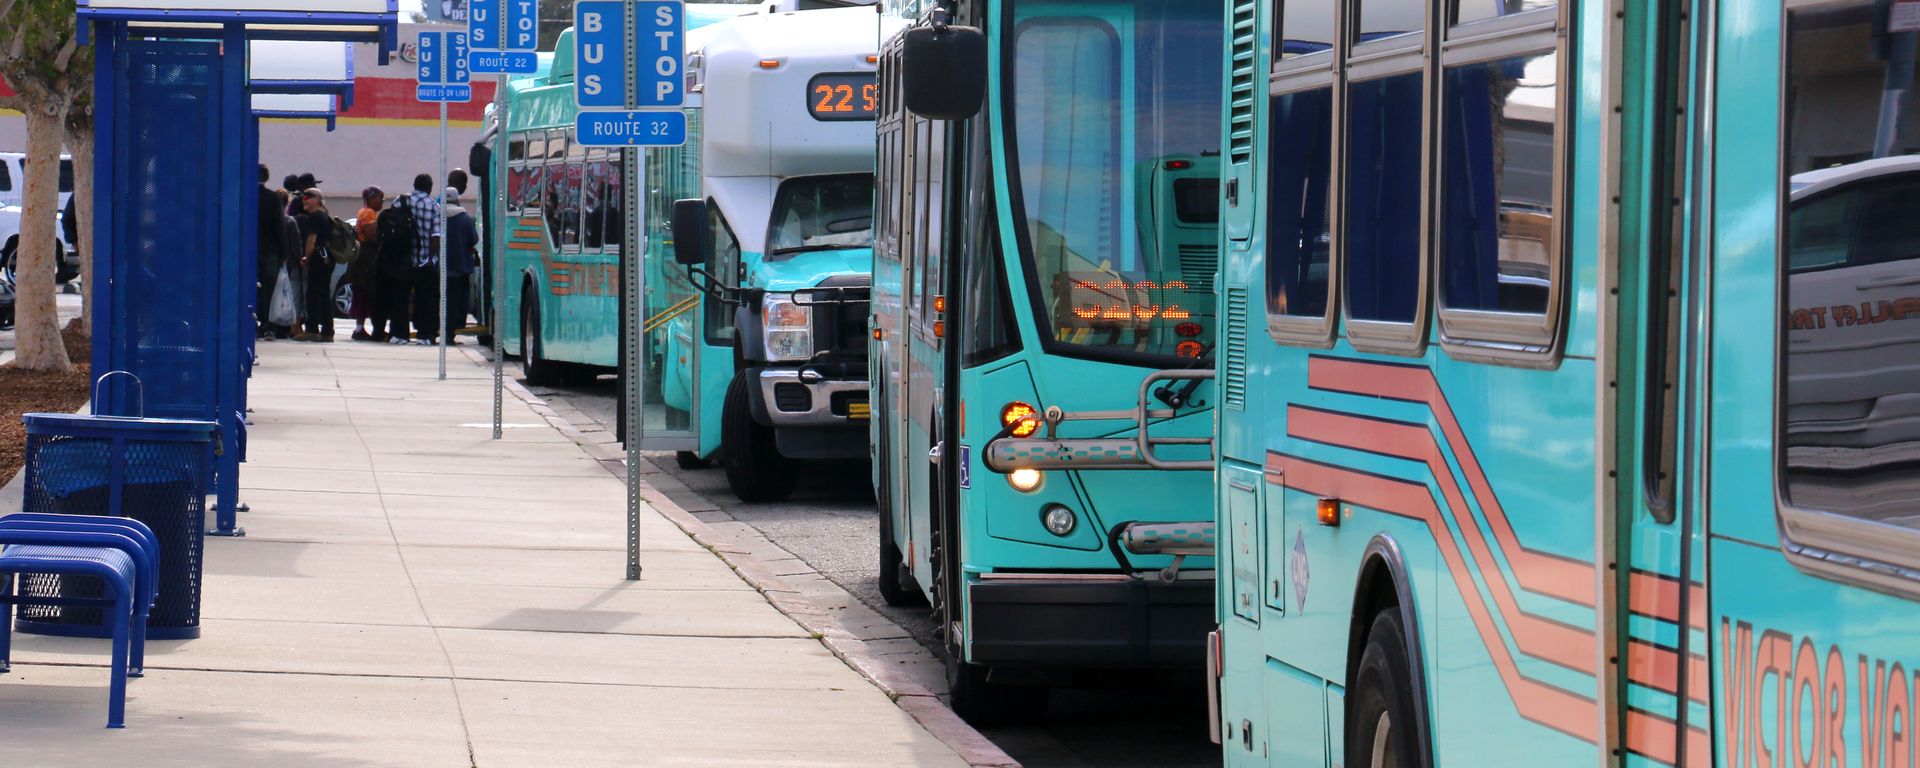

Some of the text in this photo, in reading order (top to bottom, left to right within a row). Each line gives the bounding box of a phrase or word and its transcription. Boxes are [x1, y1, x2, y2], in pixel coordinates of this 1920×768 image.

[473, 0, 487, 42] US
[421, 37, 432, 77] BUS
[455, 35, 466, 80] STOP
[479, 58, 527, 68] ROUTE 22
[583, 12, 604, 95] BUS
[655, 6, 677, 101] STOP
[418, 88, 437, 97] ROUTE
[815, 84, 878, 112] 22 S
[593, 121, 669, 136] ROUTE 32
[1721, 615, 1847, 768] VICTOR
